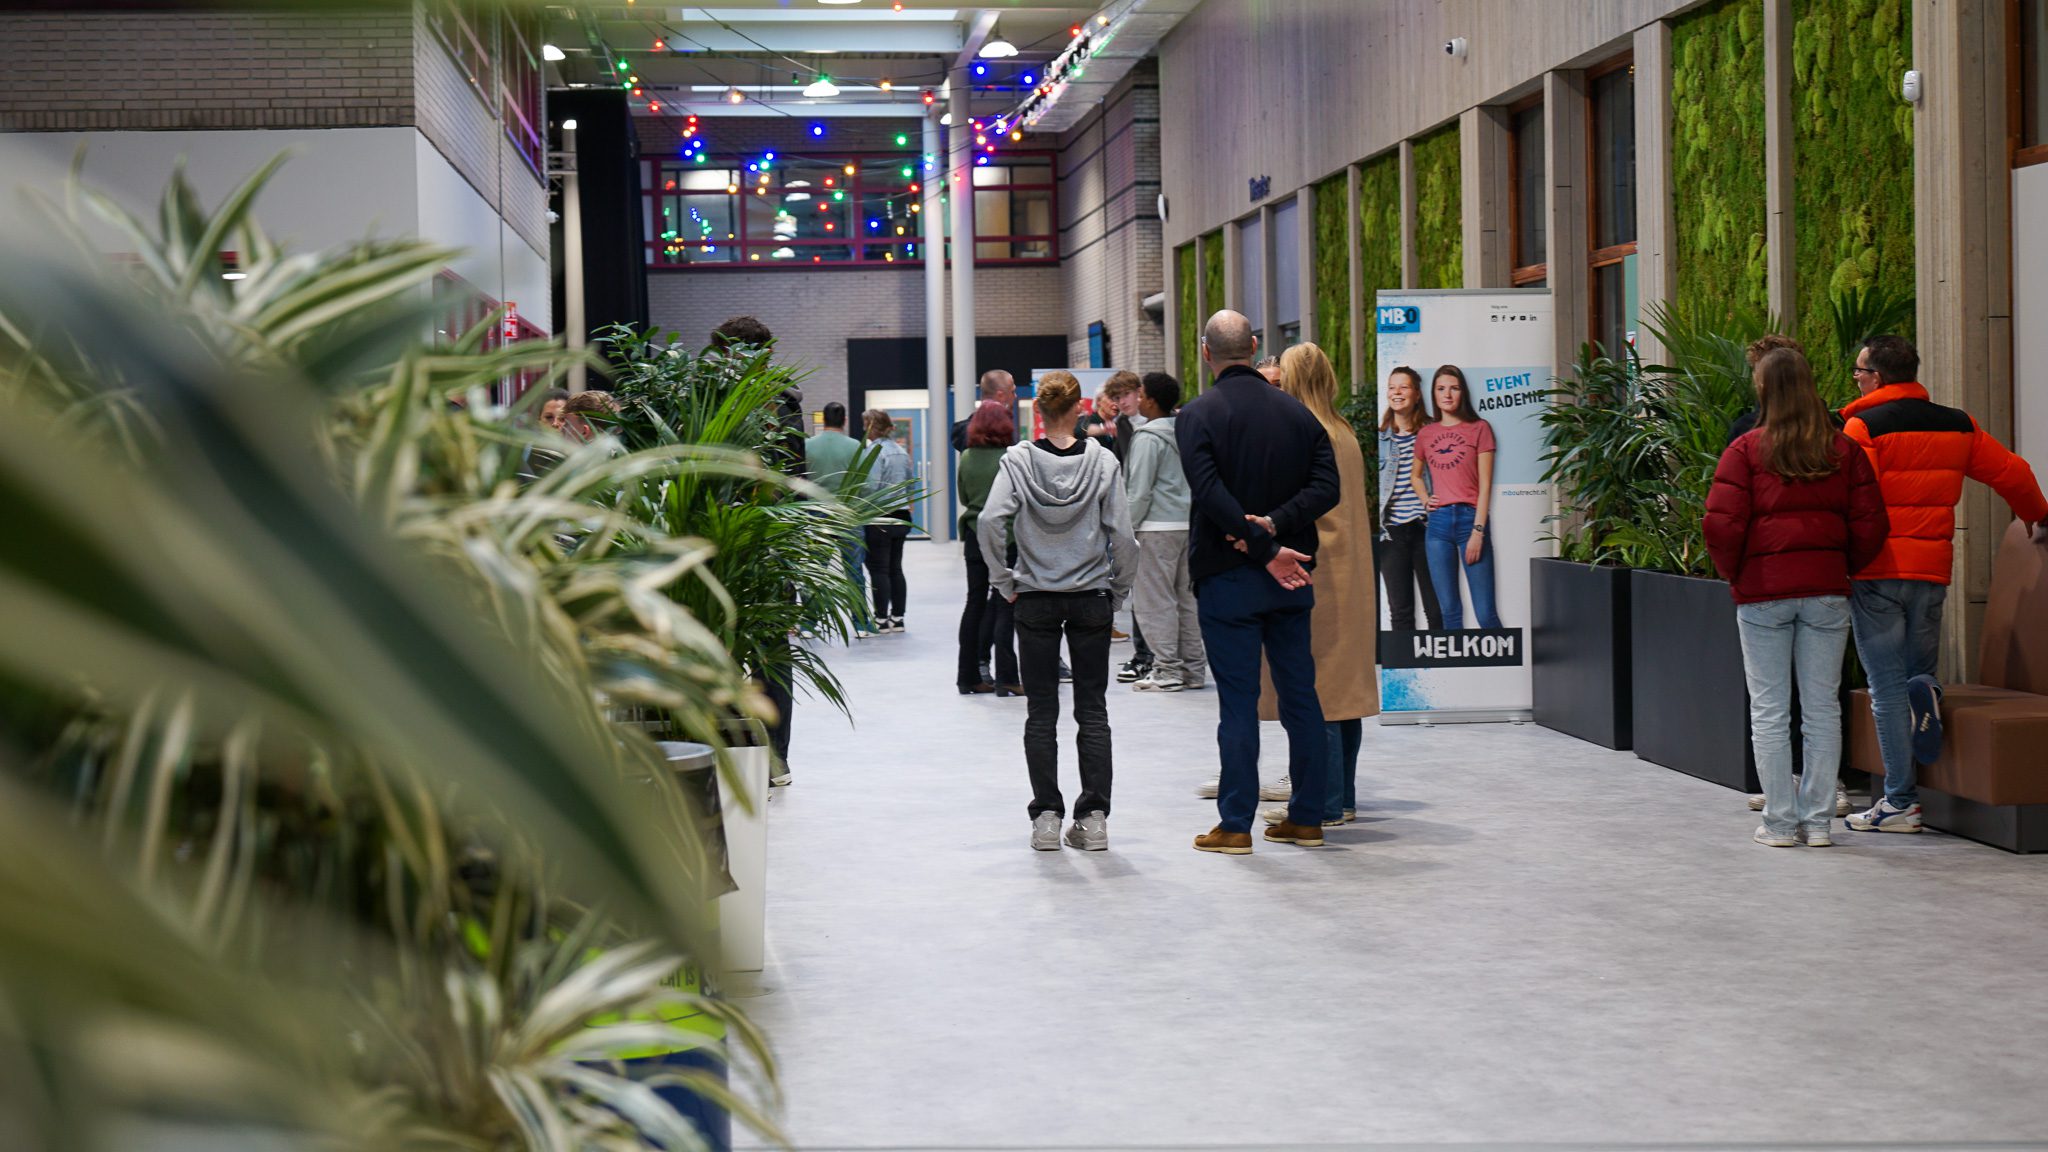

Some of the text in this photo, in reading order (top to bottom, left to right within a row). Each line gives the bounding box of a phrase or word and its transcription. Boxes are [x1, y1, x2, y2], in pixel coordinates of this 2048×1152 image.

[1380, 308, 1417, 324] MBO
[1486, 373, 1531, 392] EVENT
[1413, 634, 1514, 659] WELKOM
